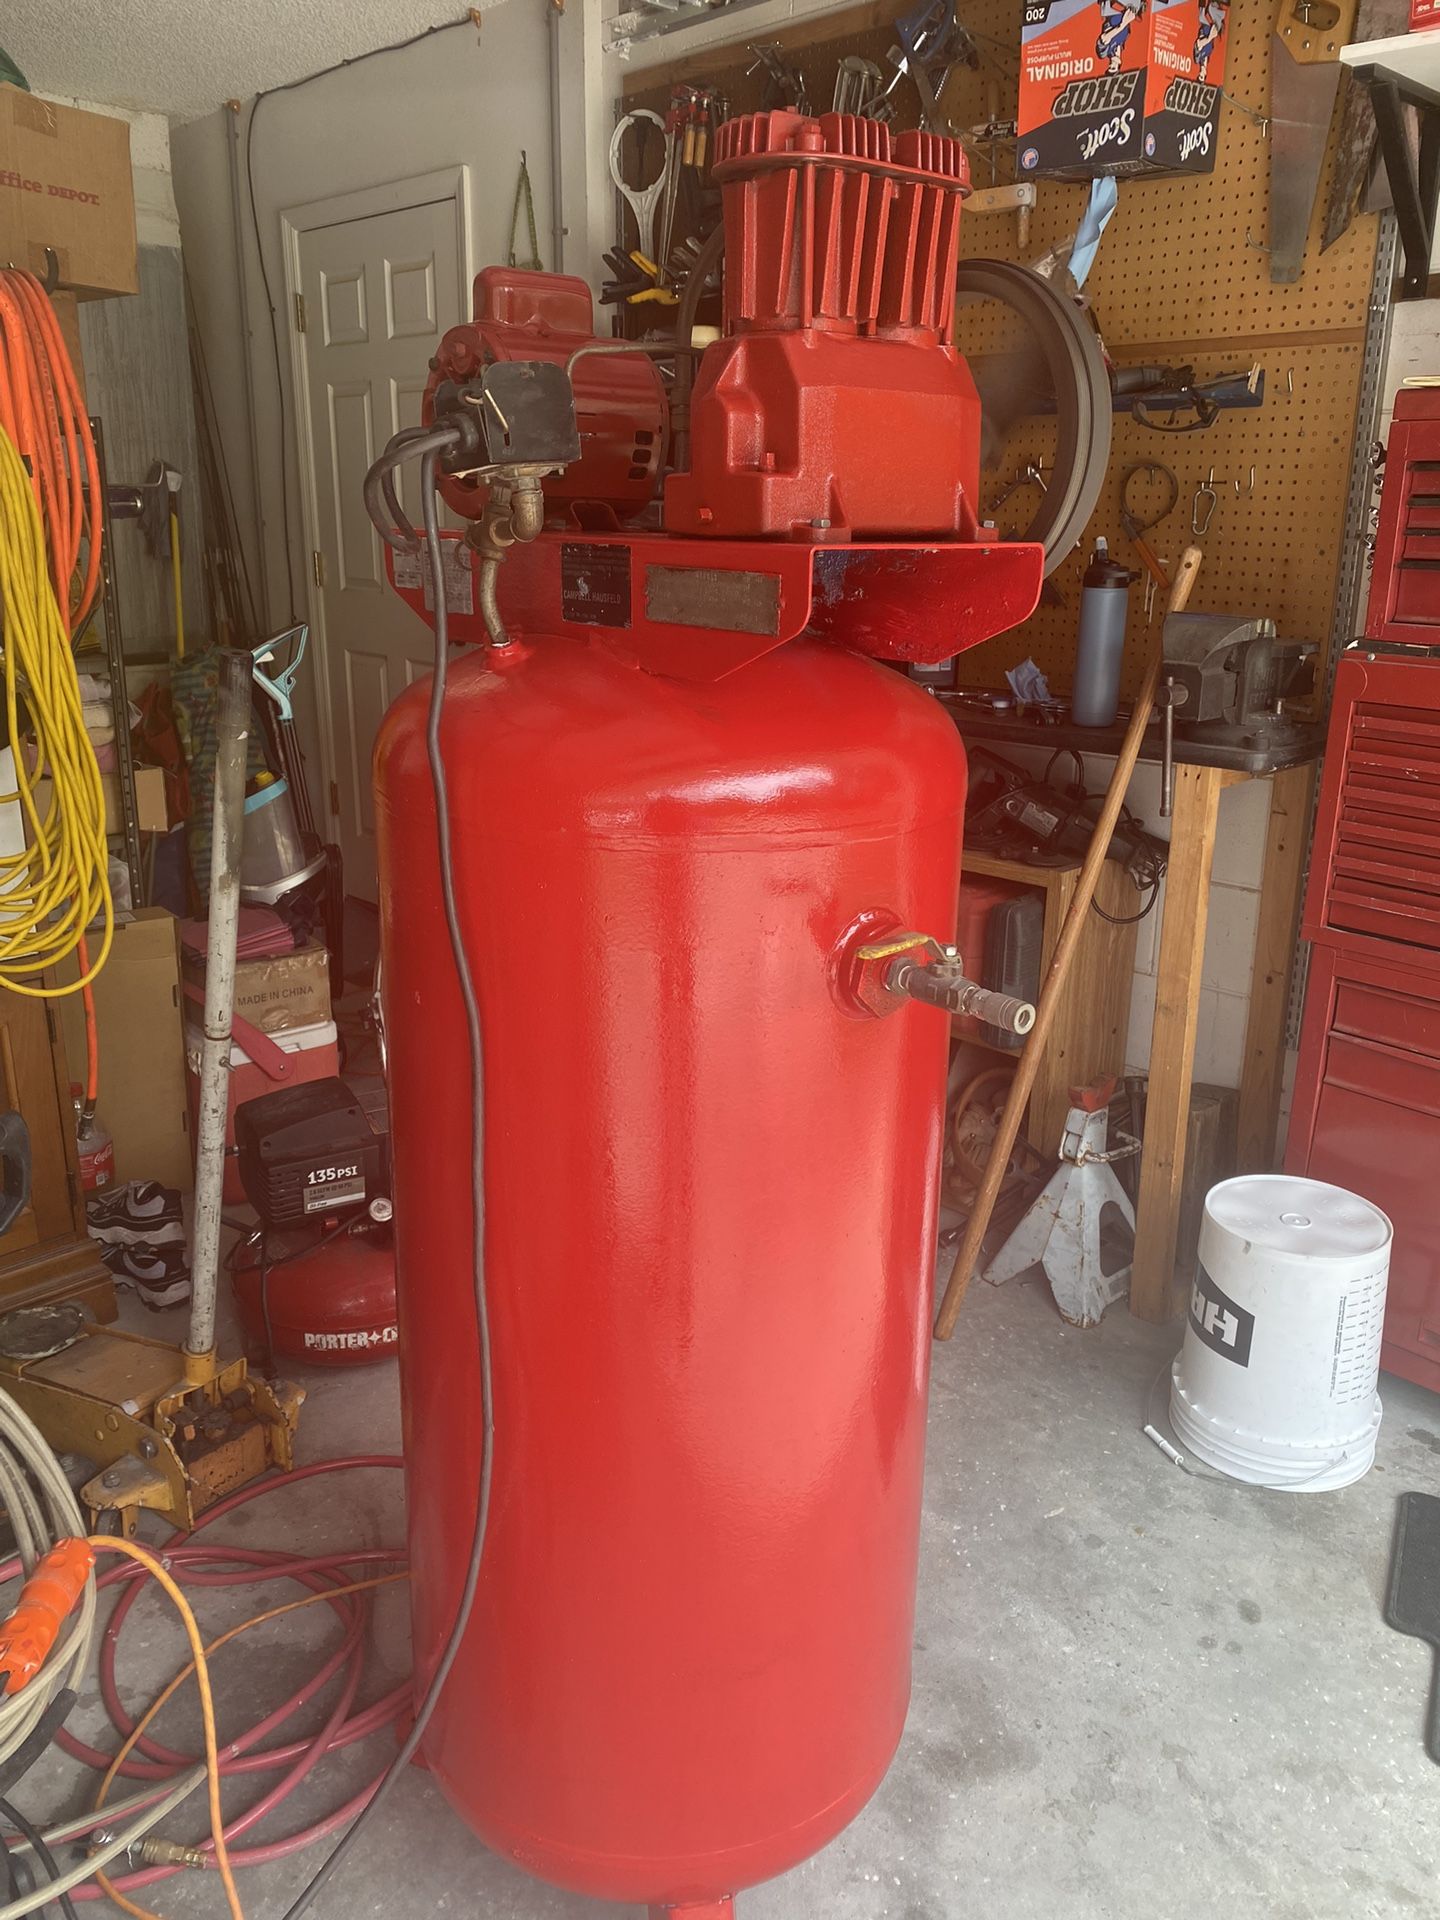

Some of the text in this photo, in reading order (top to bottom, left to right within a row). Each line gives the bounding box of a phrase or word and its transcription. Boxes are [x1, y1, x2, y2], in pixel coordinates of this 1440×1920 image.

[1026, 7, 1045, 21] 200
[1026, 57, 1094, 82] ORIGINAL
[1153, 46, 1192, 73] ORIGINAL
[1052, 70, 1140, 119] SHOP
[1164, 76, 1218, 119] SHOP
[1082, 107, 1136, 160] Scott
[1180, 121, 1213, 161] Scott
[0, 170, 43, 194] ffice
[237, 985, 314, 1006] MADE IN CHINA
